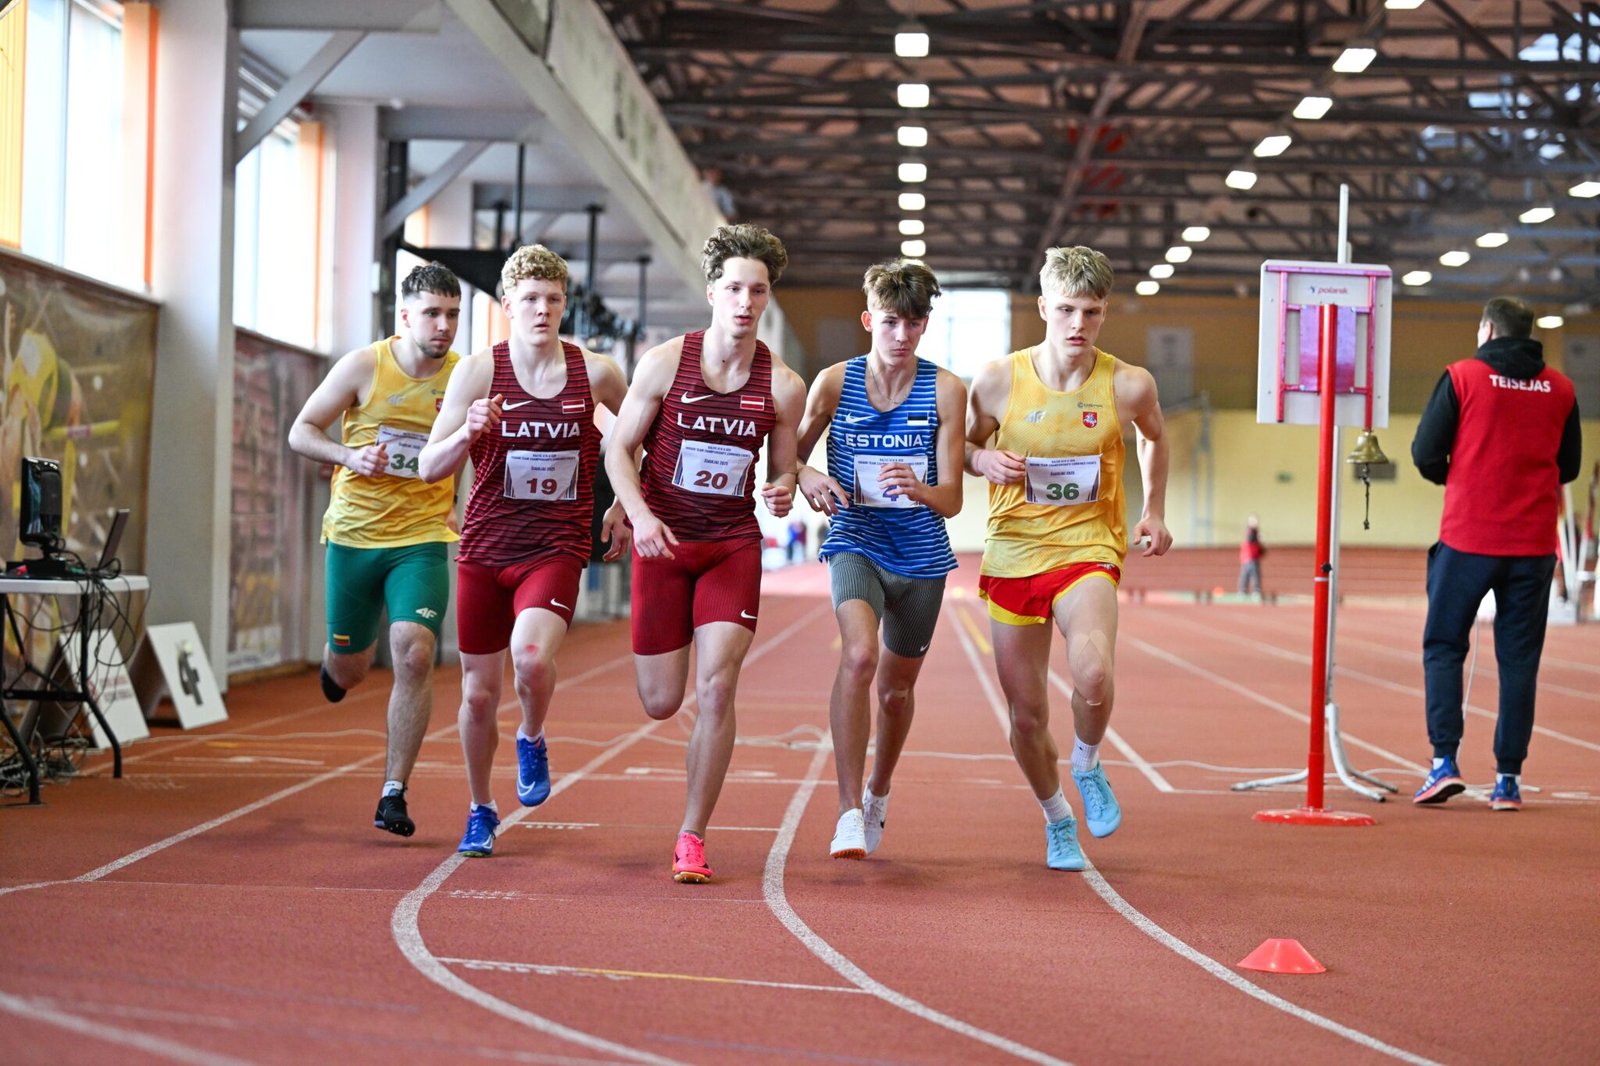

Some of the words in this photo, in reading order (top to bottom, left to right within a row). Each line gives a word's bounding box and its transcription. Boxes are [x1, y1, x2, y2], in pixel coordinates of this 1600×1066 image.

[501, 420, 580, 439] LATVIA
[677, 412, 757, 437] LATVIA
[845, 433, 923, 448] ESTONIA
[390, 453, 418, 473] 34
[526, 477, 557, 496] 19
[693, 470, 728, 490] 20
[1046, 482, 1080, 501] 36
[415, 607, 438, 619] 4F
